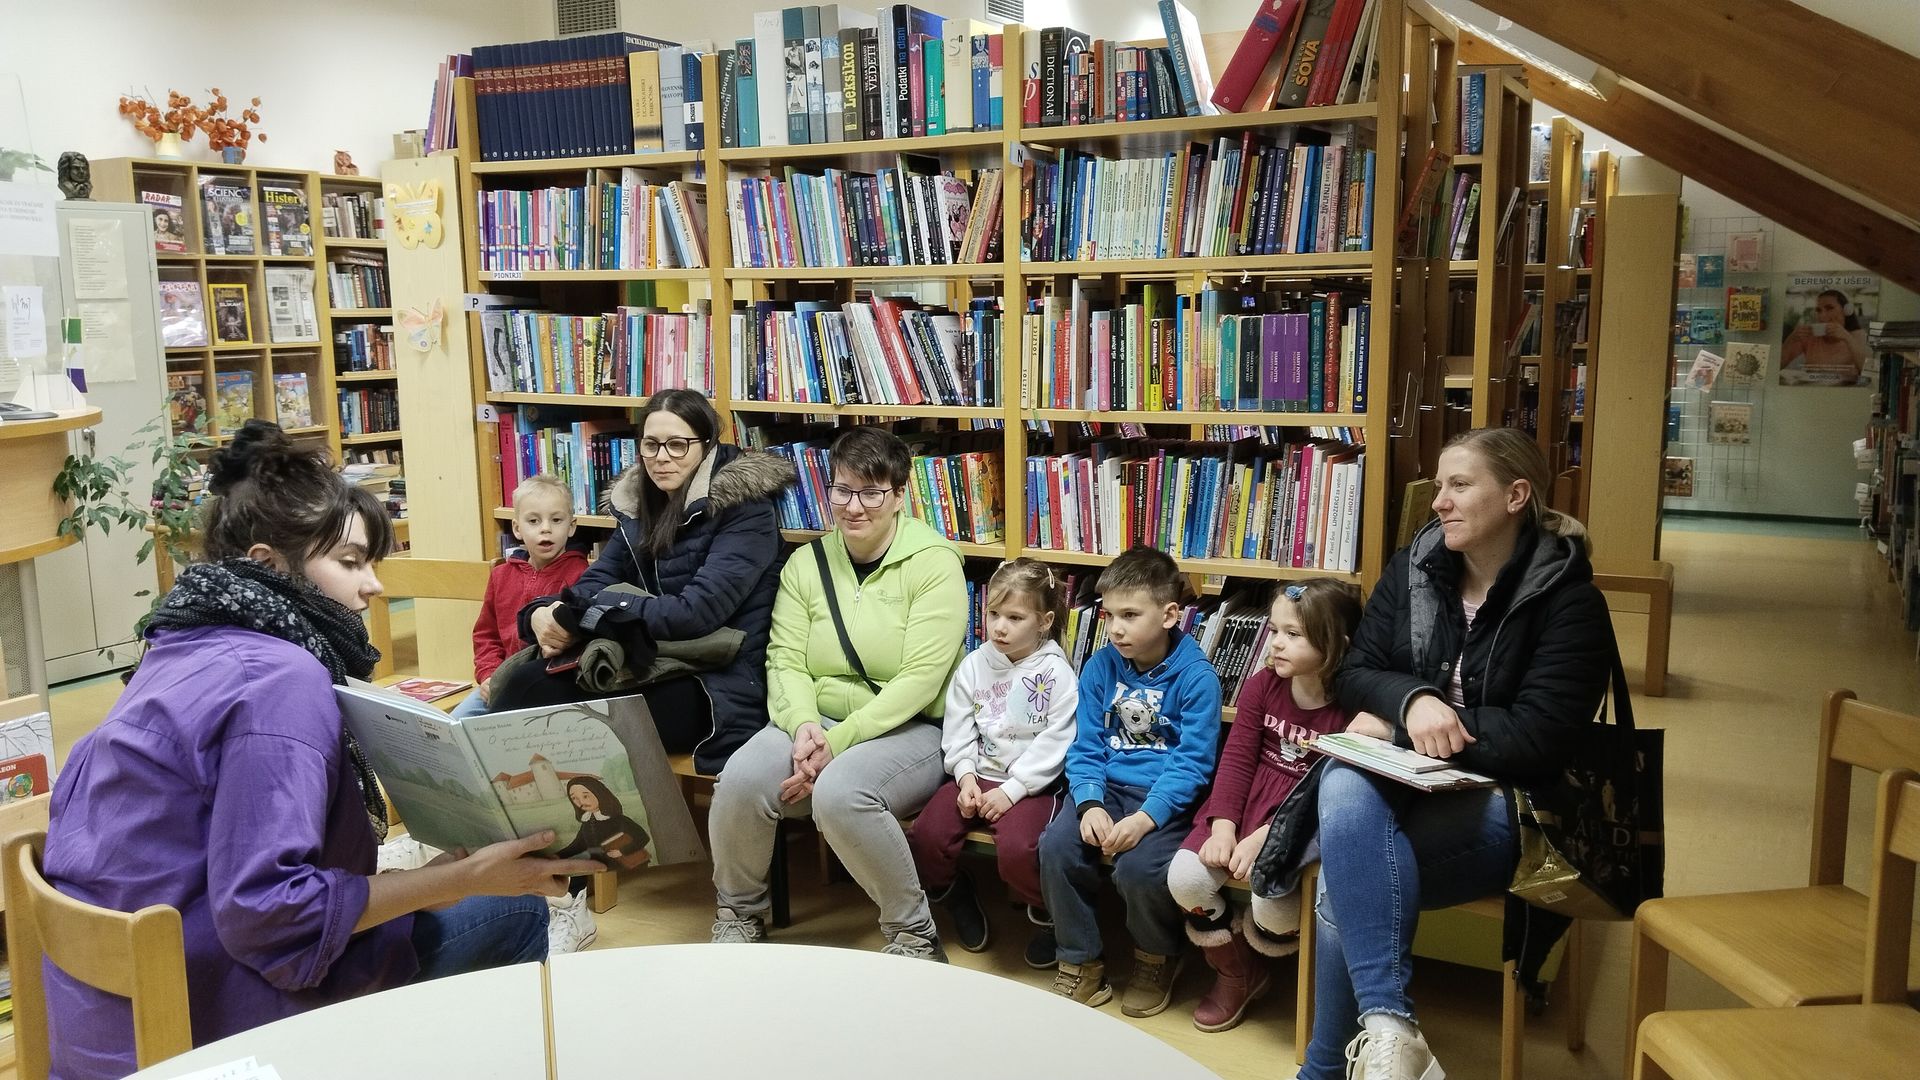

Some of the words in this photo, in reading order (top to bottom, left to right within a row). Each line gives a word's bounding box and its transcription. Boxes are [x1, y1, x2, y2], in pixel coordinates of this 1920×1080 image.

[896, 27, 906, 49] dlani
[868, 44, 878, 91] VEDETI
[899, 52, 907, 63] na
[1170, 32, 1187, 76] SLIKOVNI
[1295, 39, 1321, 88] SOVA
[843, 42, 856, 108] Leksikon
[898, 66, 909, 100] Podatki
[1046, 56, 1055, 118] DICTIONAR
[1017, 145, 1023, 162] N
[144, 194, 171, 204] RADAR
[670, 185, 681, 213] PRAVLJICE
[1320, 183, 1331, 214] ŽIVLJENJE
[1794, 277, 1835, 286] BEREMO
[1835, 277, 1842, 285] Z
[1843, 275, 1871, 285] UŠESI
[472, 298, 479, 308] P
[484, 408, 490, 419] S
[1332, 496, 1340, 527] LIHOŽERCI
[1347, 484, 1355, 516] LIHOŽERCI
[1111, 681, 1165, 713] ICE
